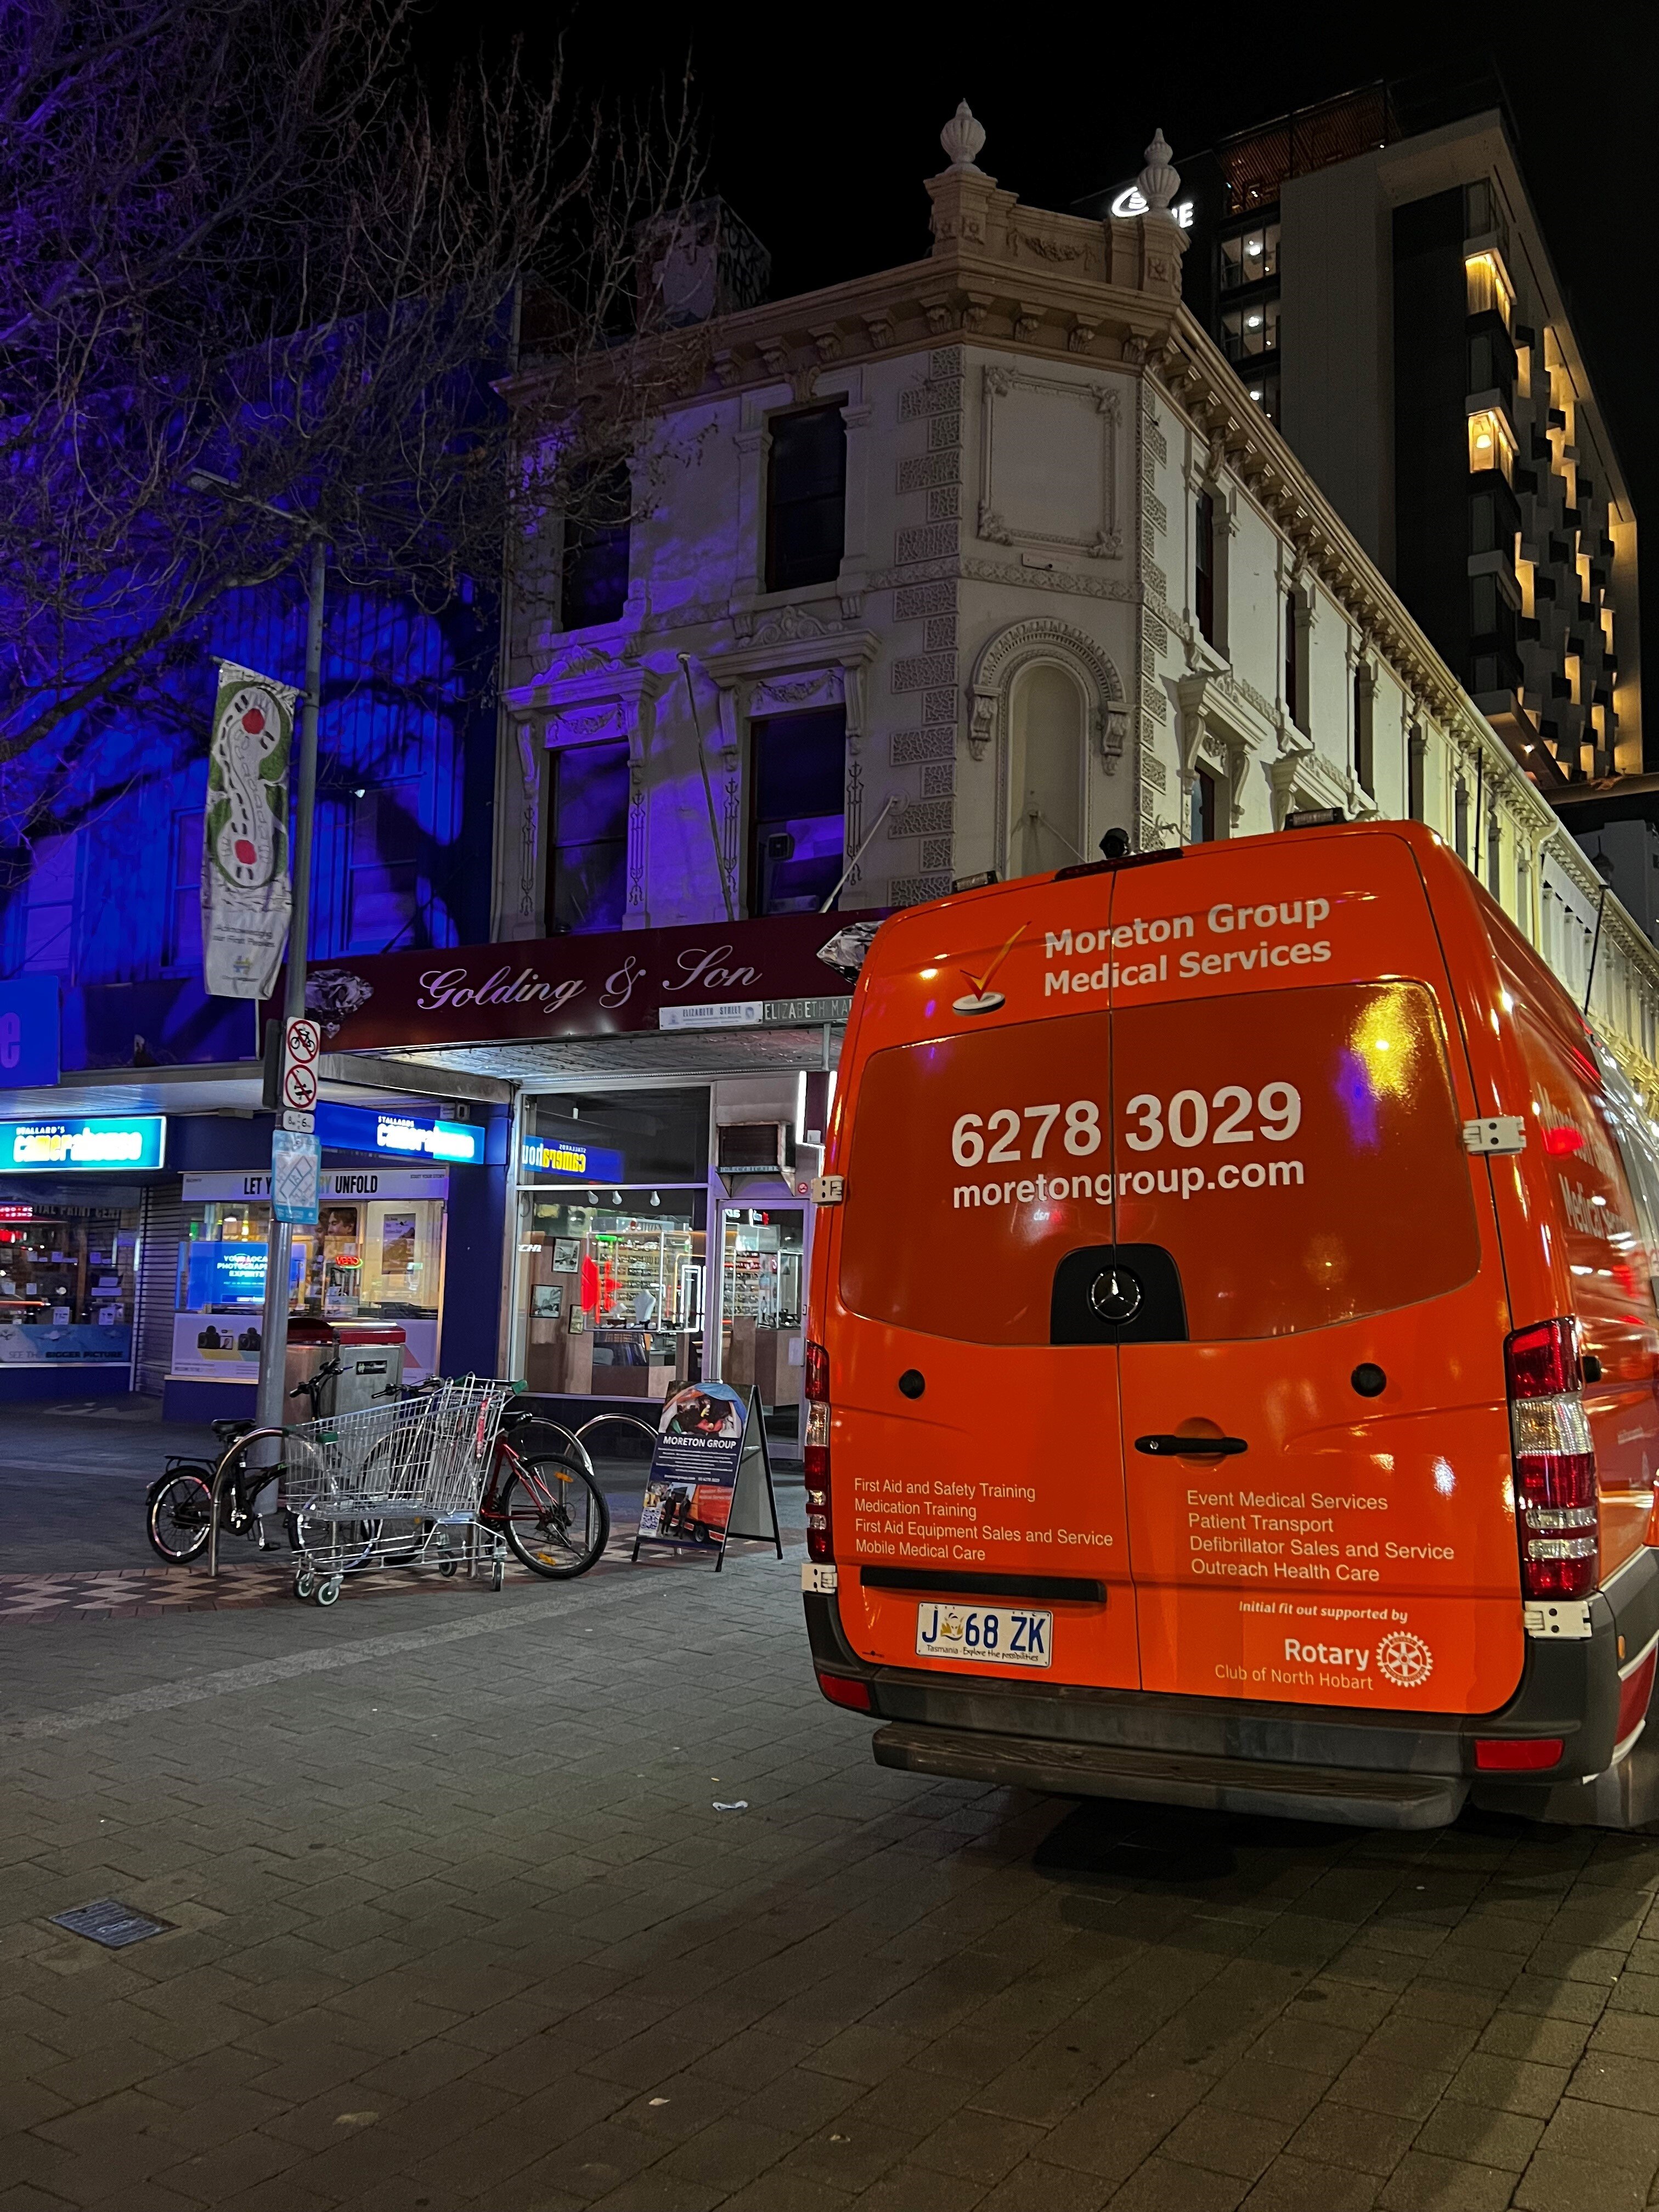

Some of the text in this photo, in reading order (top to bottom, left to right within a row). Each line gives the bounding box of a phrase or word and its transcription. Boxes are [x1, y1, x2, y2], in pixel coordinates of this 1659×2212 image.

[1045, 898, 1330, 958] Moreton Group
[417, 945, 763, 1013] Golding & Son
[1045, 940, 1331, 996] Medical Services
[683, 1005, 742, 1017] ELIZABETH STREET
[765, 1001, 825, 1020] ELIZABETH
[952, 1082, 1301, 1167] 6278 3029
[244, 1177, 262, 1195] LET
[335, 1175, 378, 1194] UNFOLD
[953, 1159, 1304, 1208] moretongroup.com
[663, 1436, 736, 1449] MORETON GROUP
[855, 1478, 1035, 1502] First Aid and Safety Training
[1188, 1490, 1388, 1510] Event Medical Services
[855, 1498, 976, 1521] Medication Training
[856, 1519, 1113, 1545] First Aid Equipment Sales and Service
[1189, 1513, 1333, 1535] Patient Transport
[856, 1539, 985, 1560] Mobile Medical Care
[1190, 1536, 1454, 1559] Defibrillator Sales and Service
[1192, 1559, 1379, 1581] Outreach Health Care
[1240, 1601, 1407, 1624] Initial fit out supported by
[922, 1610, 1046, 1653] J 68 ZK
[927, 1644, 958, 1654] Tasmania
[963, 1646, 986, 1657] Explore
[988, 1649, 1000, 1658] the
[1285, 1639, 1369, 1671] Rotary
[1216, 1664, 1373, 1690] Club of North Hobart
